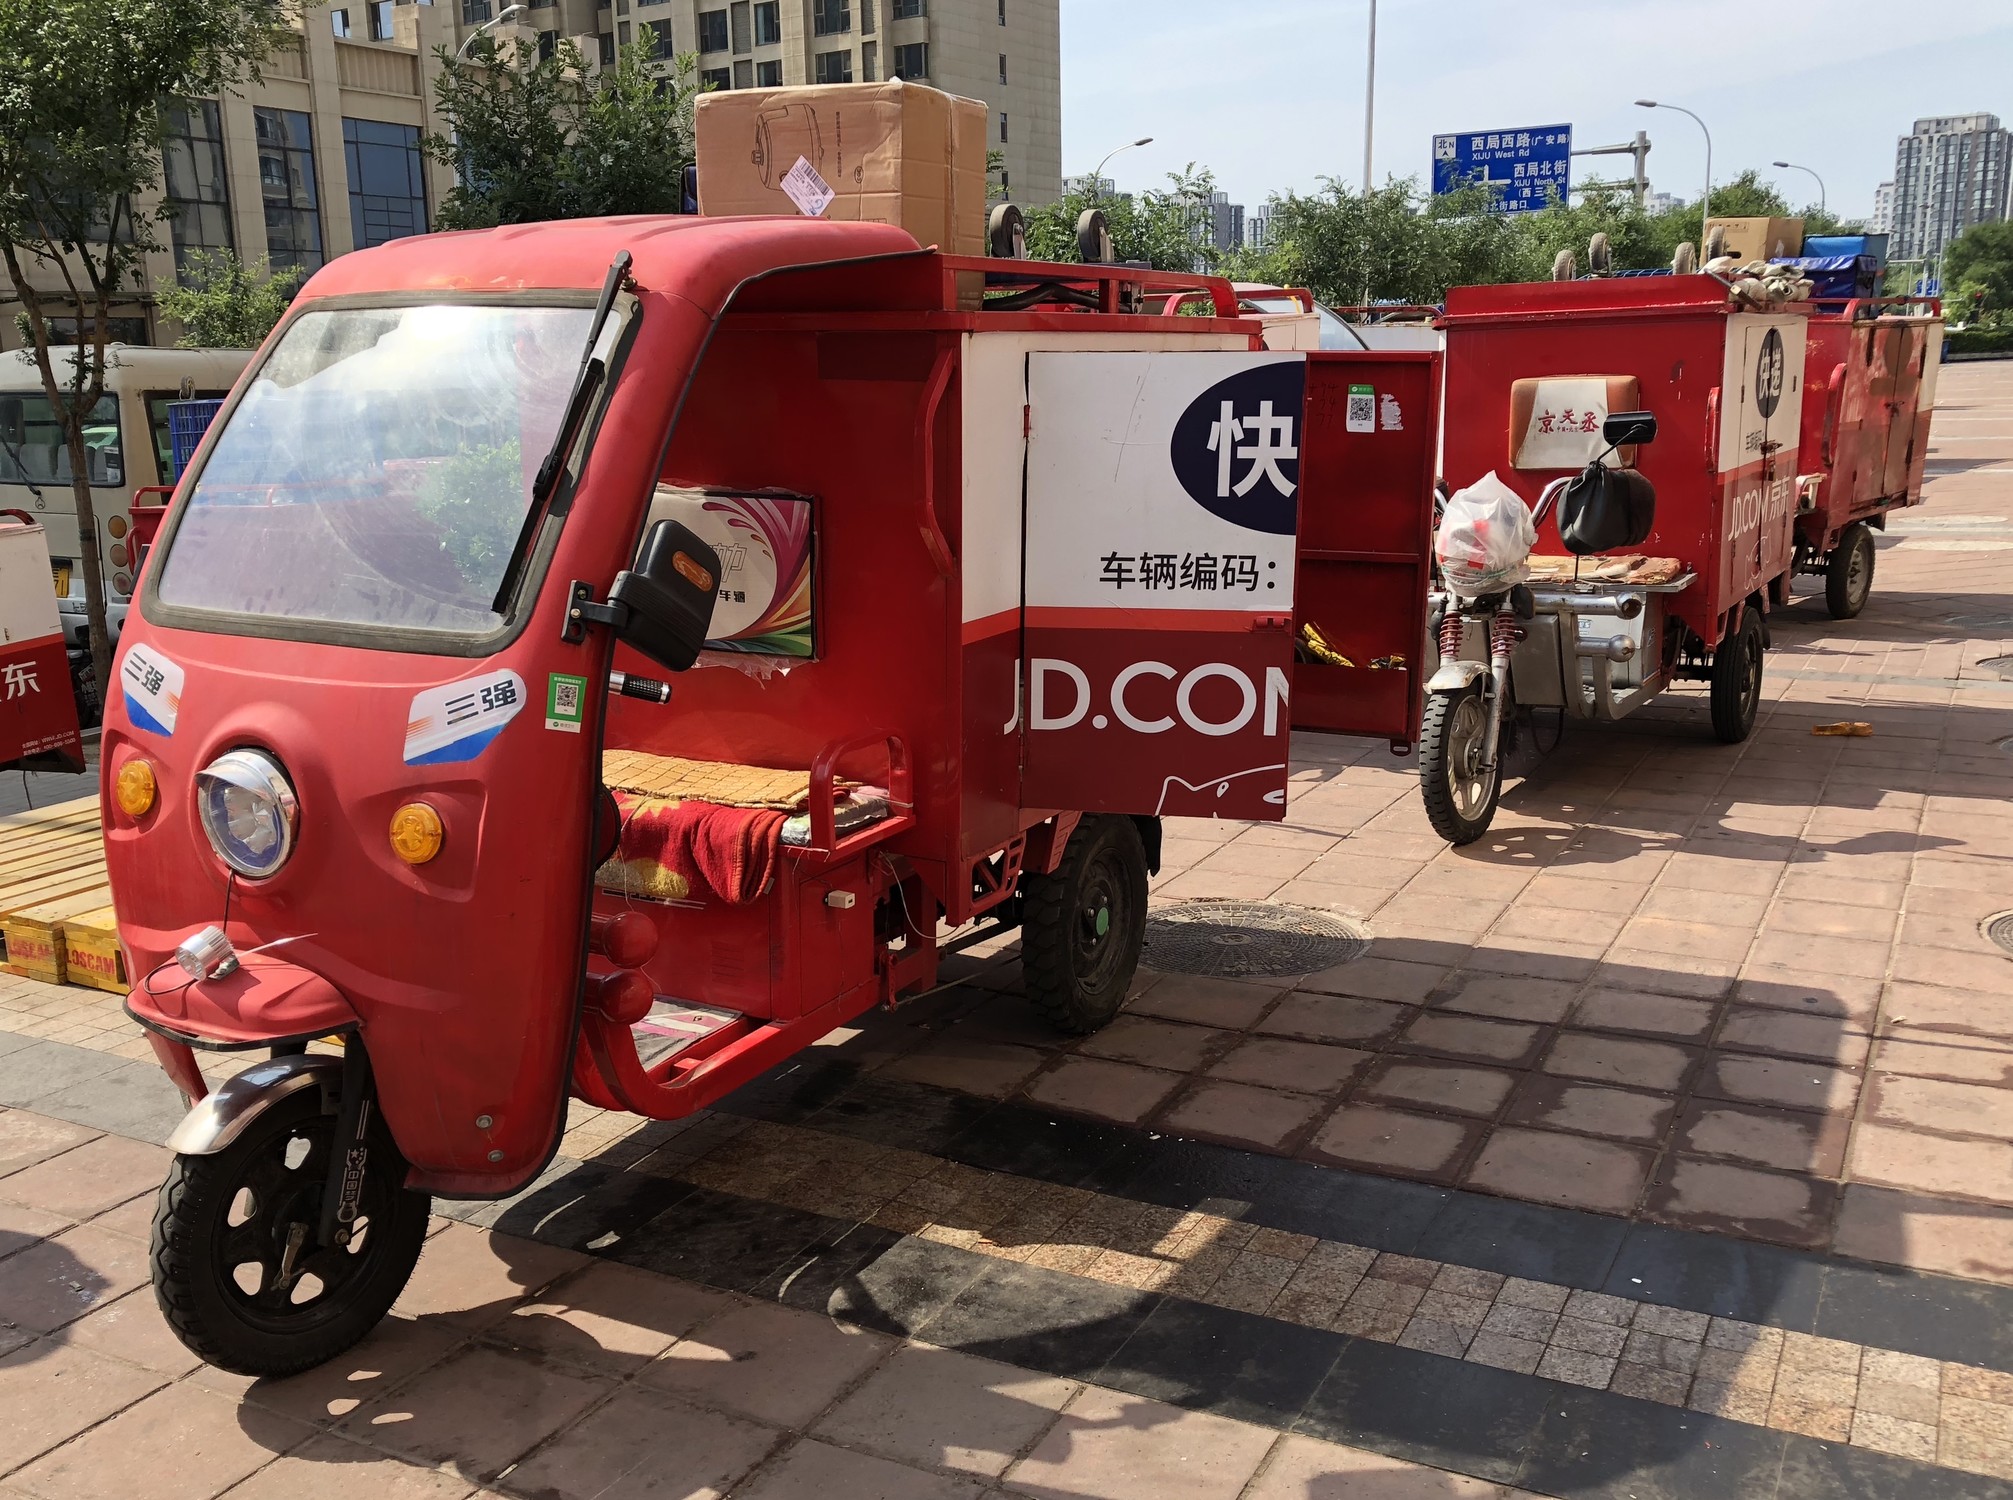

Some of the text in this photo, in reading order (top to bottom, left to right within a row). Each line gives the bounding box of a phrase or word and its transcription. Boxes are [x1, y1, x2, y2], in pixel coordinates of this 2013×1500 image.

[1472, 149, 1530, 161] XIJU West Rd
[1513, 160, 1567, 178] 西局北街
[1513, 176, 1566, 188] XIJU North St
[1206, 400, 1299, 498] 快
[1728, 485, 1770, 541] JD.COM
[1769, 475, 1790, 522] 京东
[1099, 551, 1277, 592] 车辆编码：
[1, 660, 41, 701] 东
[124, 651, 165, 696] 三强
[445, 679, 517, 726] 三强
[65, 948, 115, 975] LOSCAM
